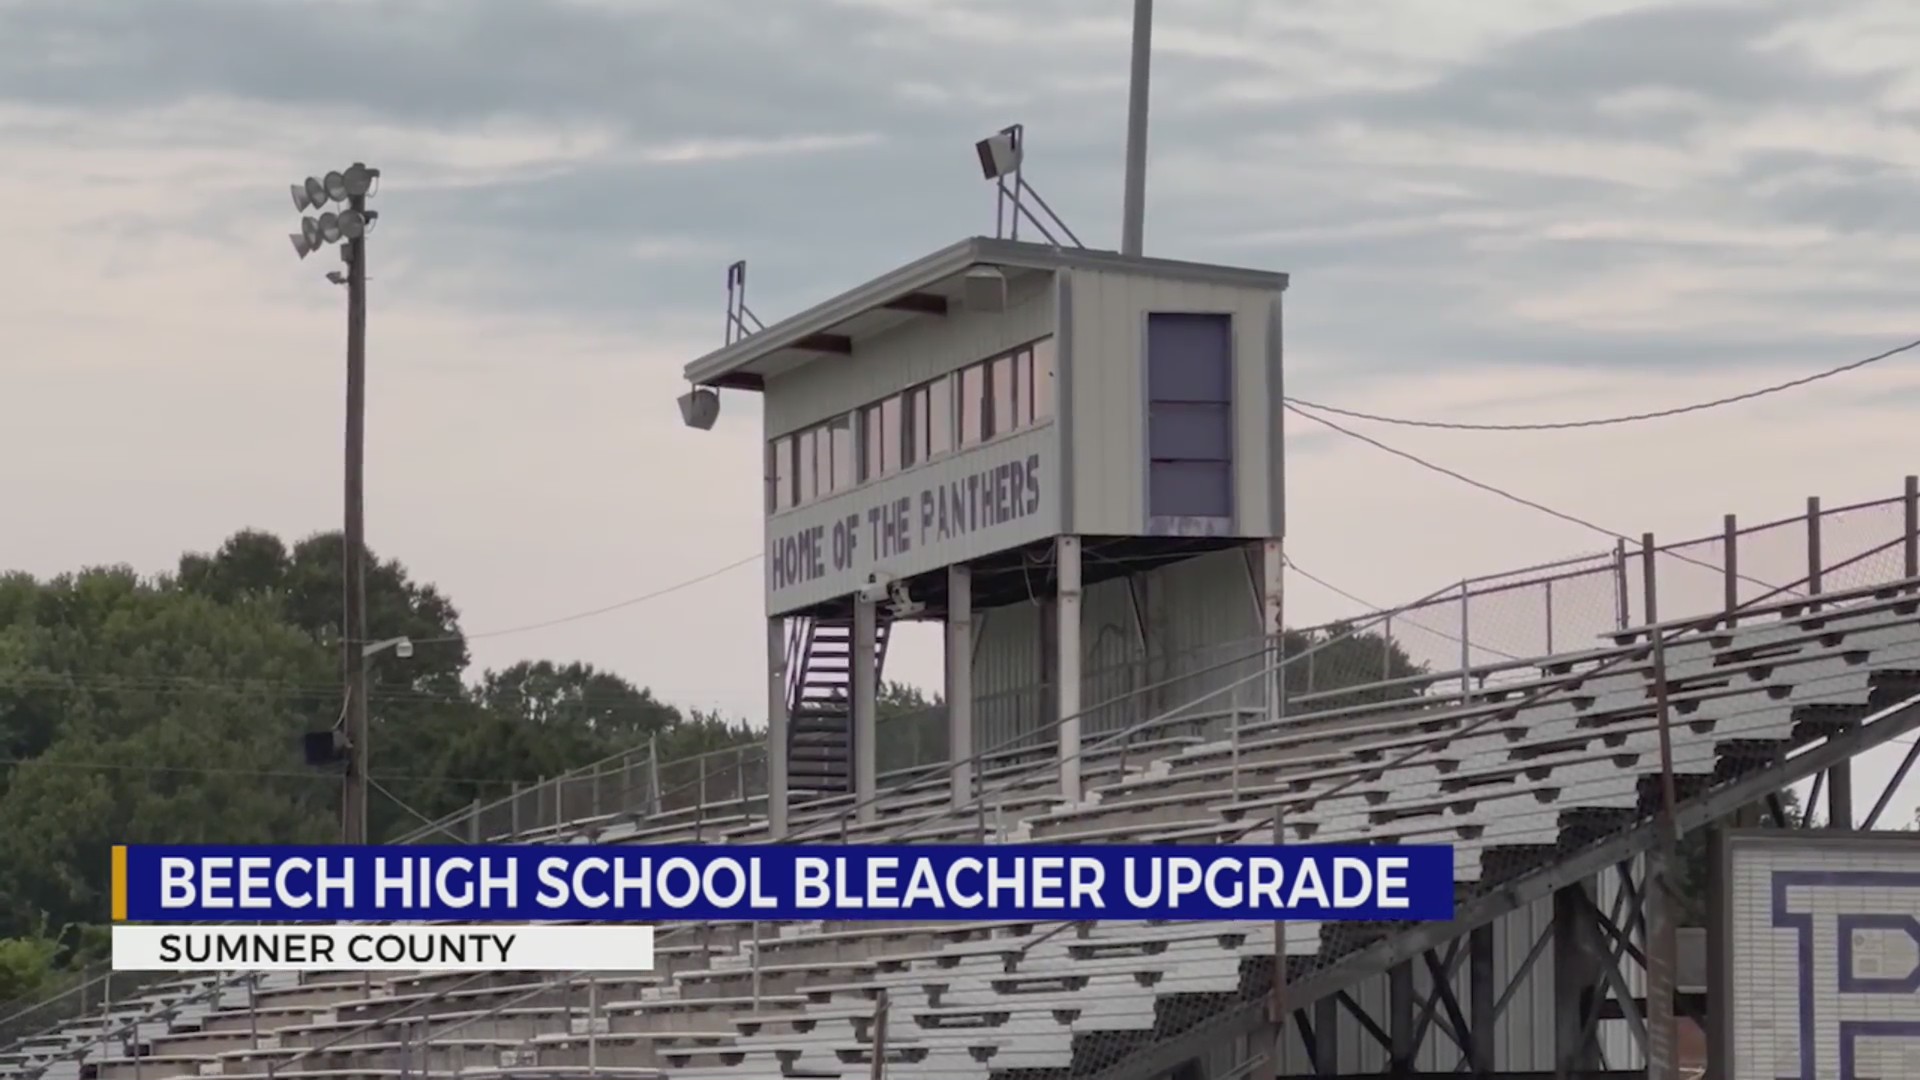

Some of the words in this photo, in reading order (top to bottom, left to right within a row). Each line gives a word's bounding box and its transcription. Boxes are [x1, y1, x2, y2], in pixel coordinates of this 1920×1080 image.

[772, 525, 825, 592] HOME
[833, 513, 859, 572] OF
[868, 497, 911, 561] THE
[920, 453, 1040, 546] PANTHERS
